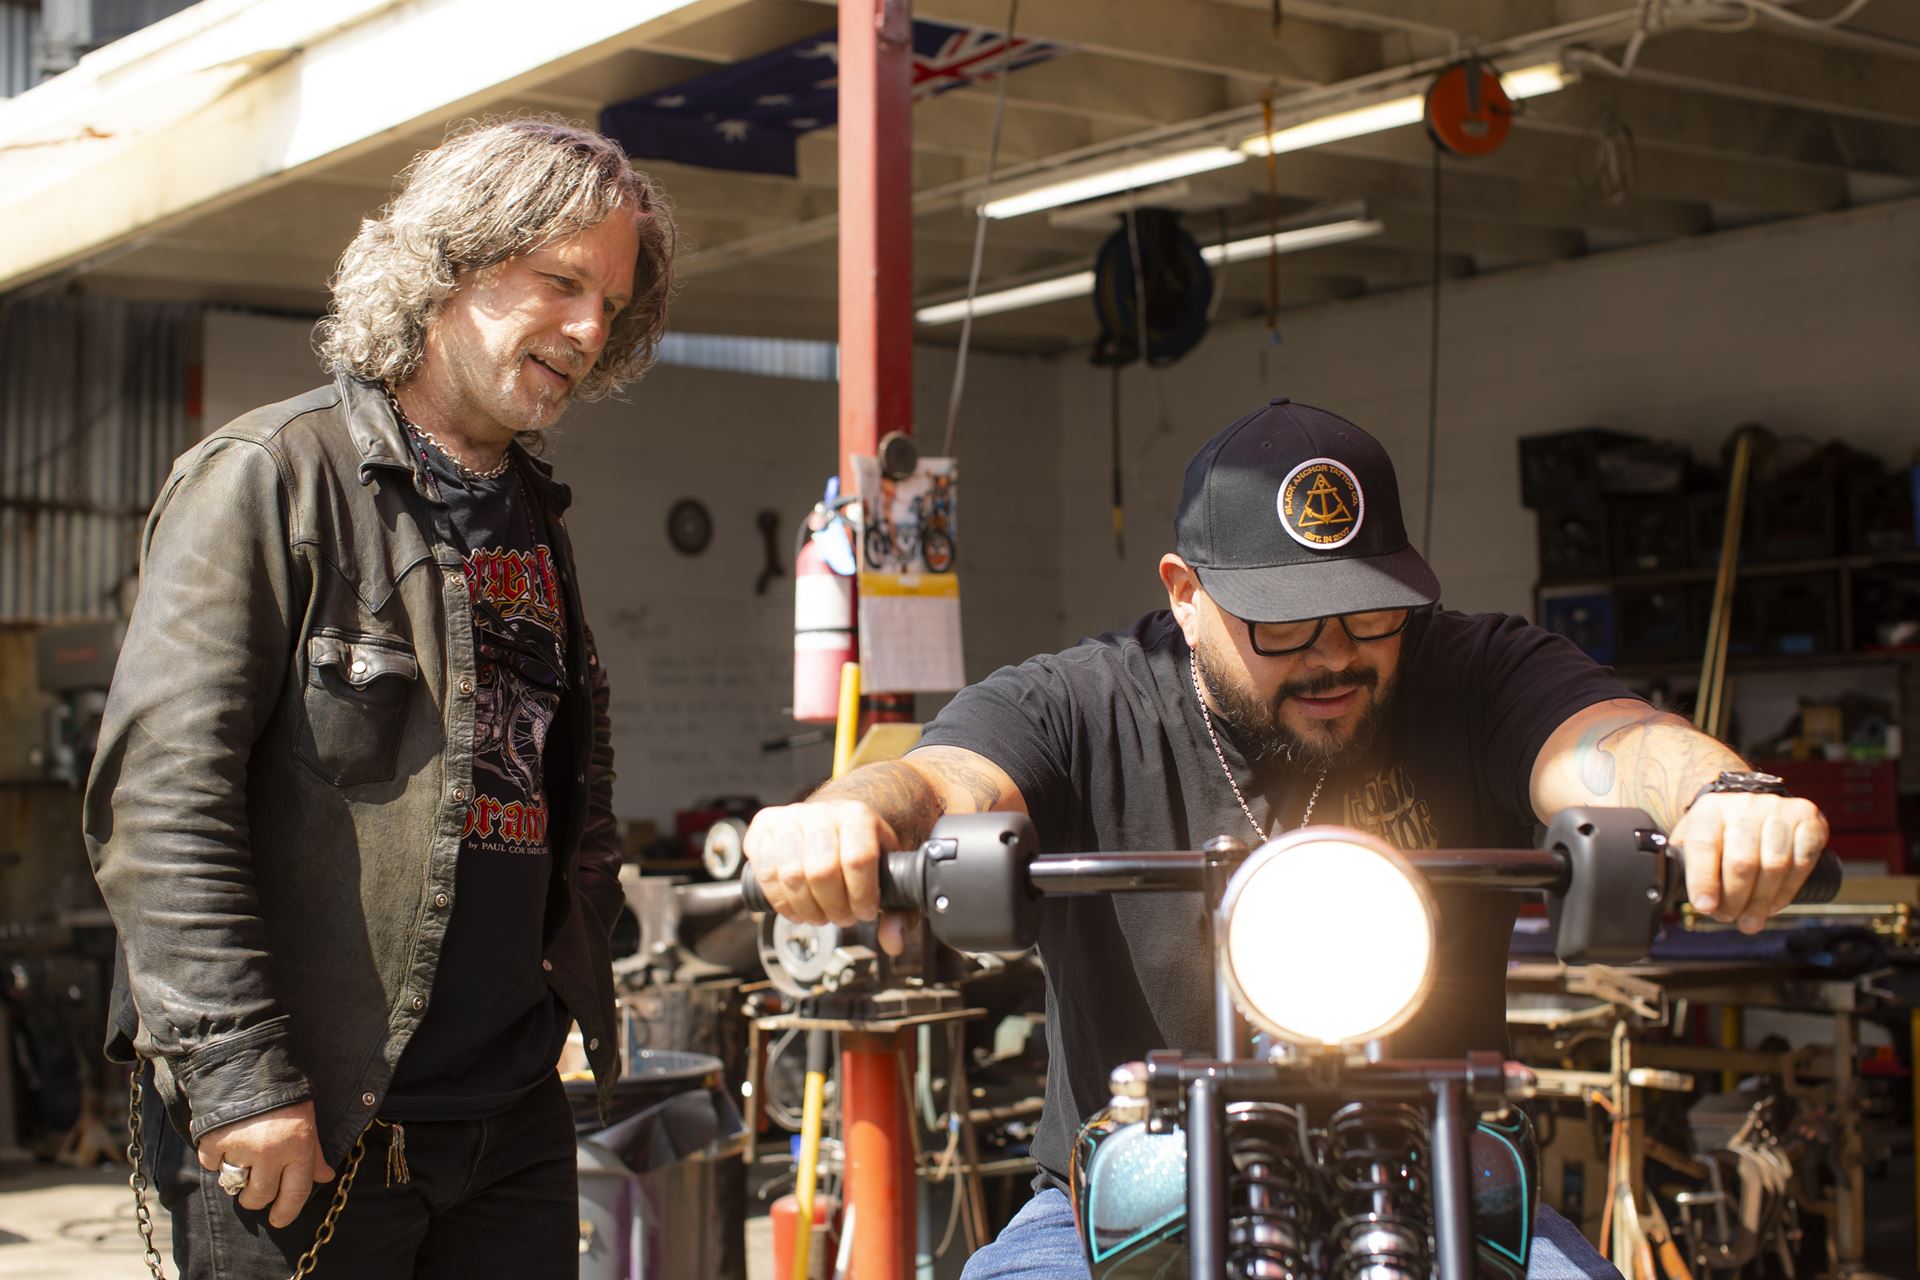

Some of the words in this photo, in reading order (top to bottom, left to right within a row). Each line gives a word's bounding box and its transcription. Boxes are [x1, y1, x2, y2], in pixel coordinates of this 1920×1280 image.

[1285, 484, 1296, 515] BLACK
[1293, 465, 1328, 485] ANCHOR
[1329, 466, 1355, 490] TATTOO
[1323, 536, 1332, 544] IN
[468, 841, 479, 851] by
[481, 842, 506, 852] PAUL
[508, 846, 526, 854] COX
